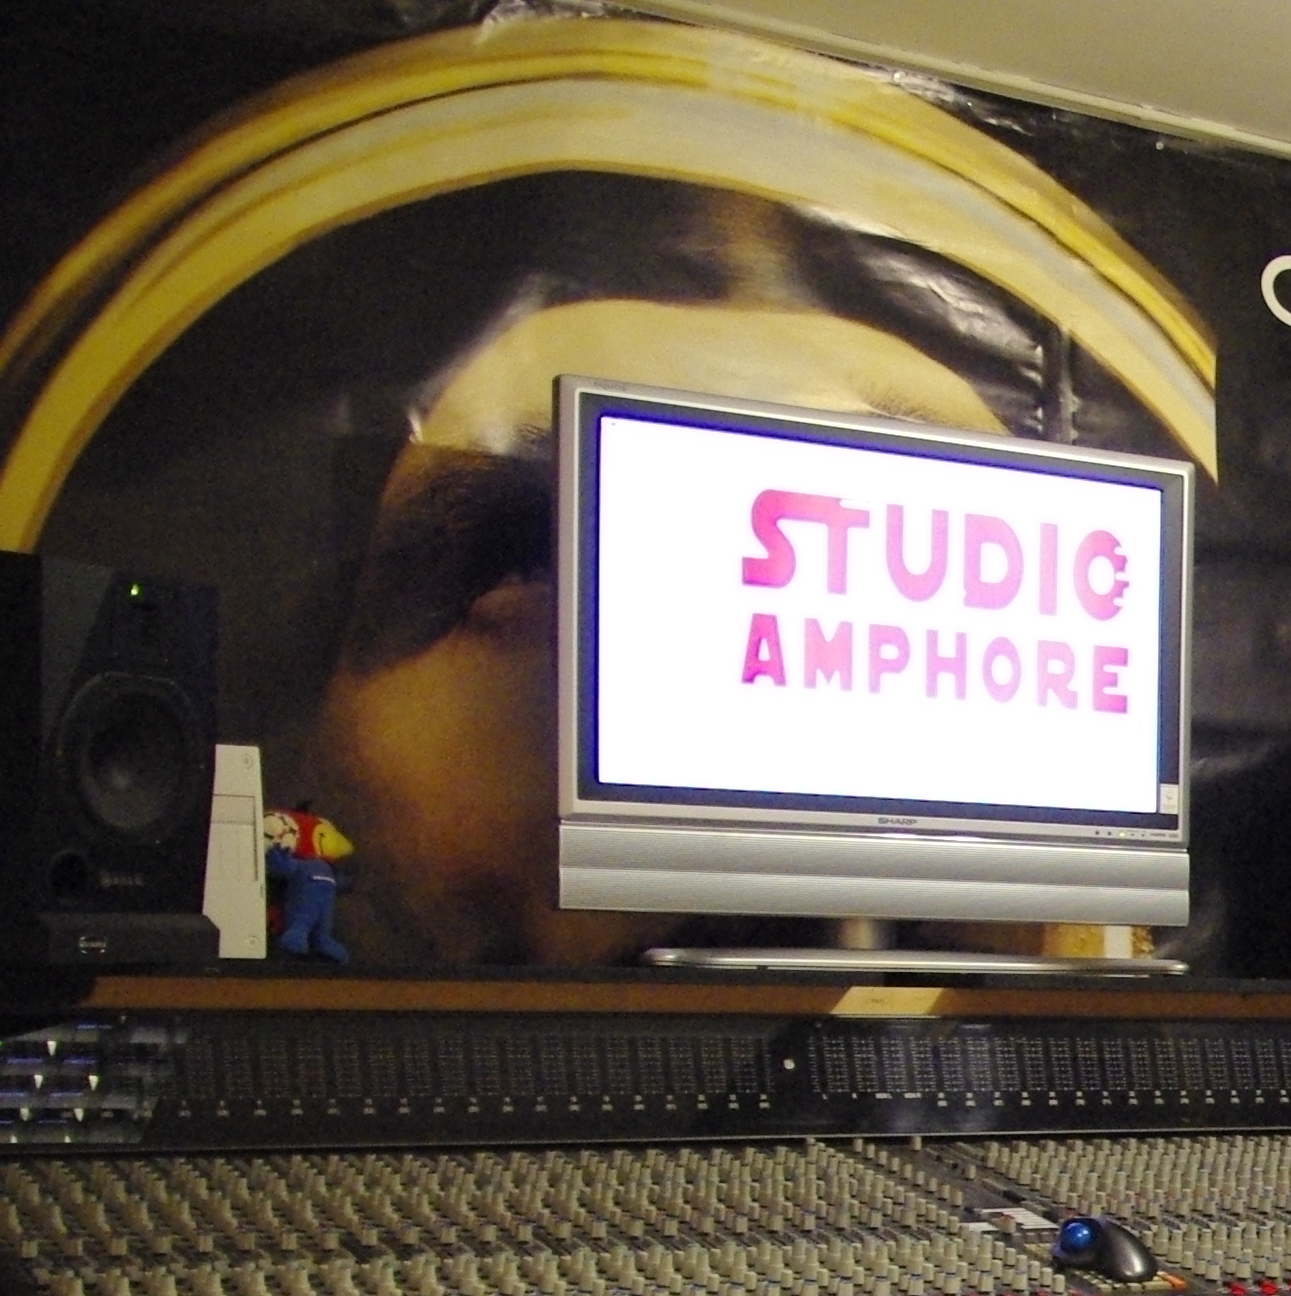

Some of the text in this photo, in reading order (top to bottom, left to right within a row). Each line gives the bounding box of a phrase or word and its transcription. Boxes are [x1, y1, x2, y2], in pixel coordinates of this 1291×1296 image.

[741, 489, 1130, 621] STUDIO
[741, 613, 1129, 713] AMPHORE
[878, 817, 917, 825] SHARP
